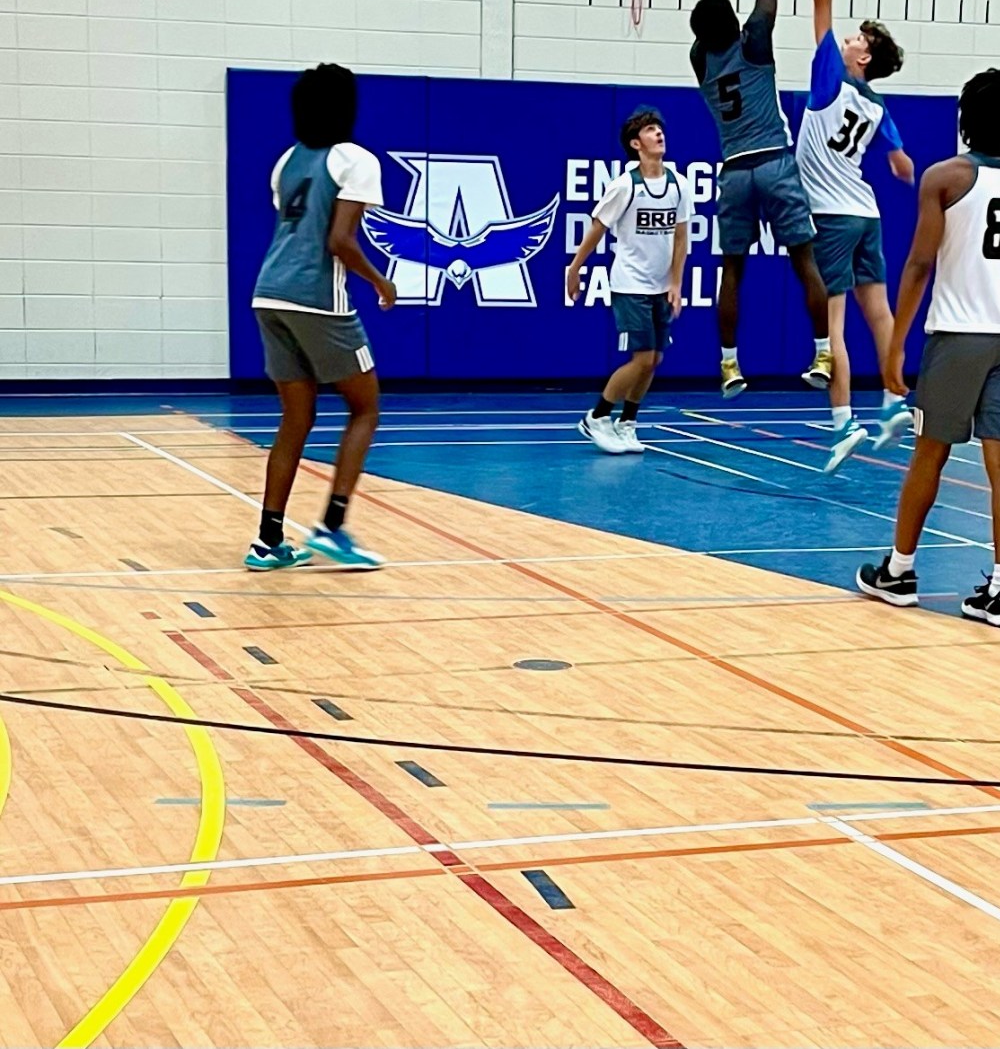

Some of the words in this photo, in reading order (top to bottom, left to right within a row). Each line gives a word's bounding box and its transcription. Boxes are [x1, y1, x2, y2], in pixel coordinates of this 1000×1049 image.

[717, 72, 742, 121] 5
[827, 109, 870, 157] 31
[286, 178, 313, 233] 4
[637, 212, 676, 227] BRB
